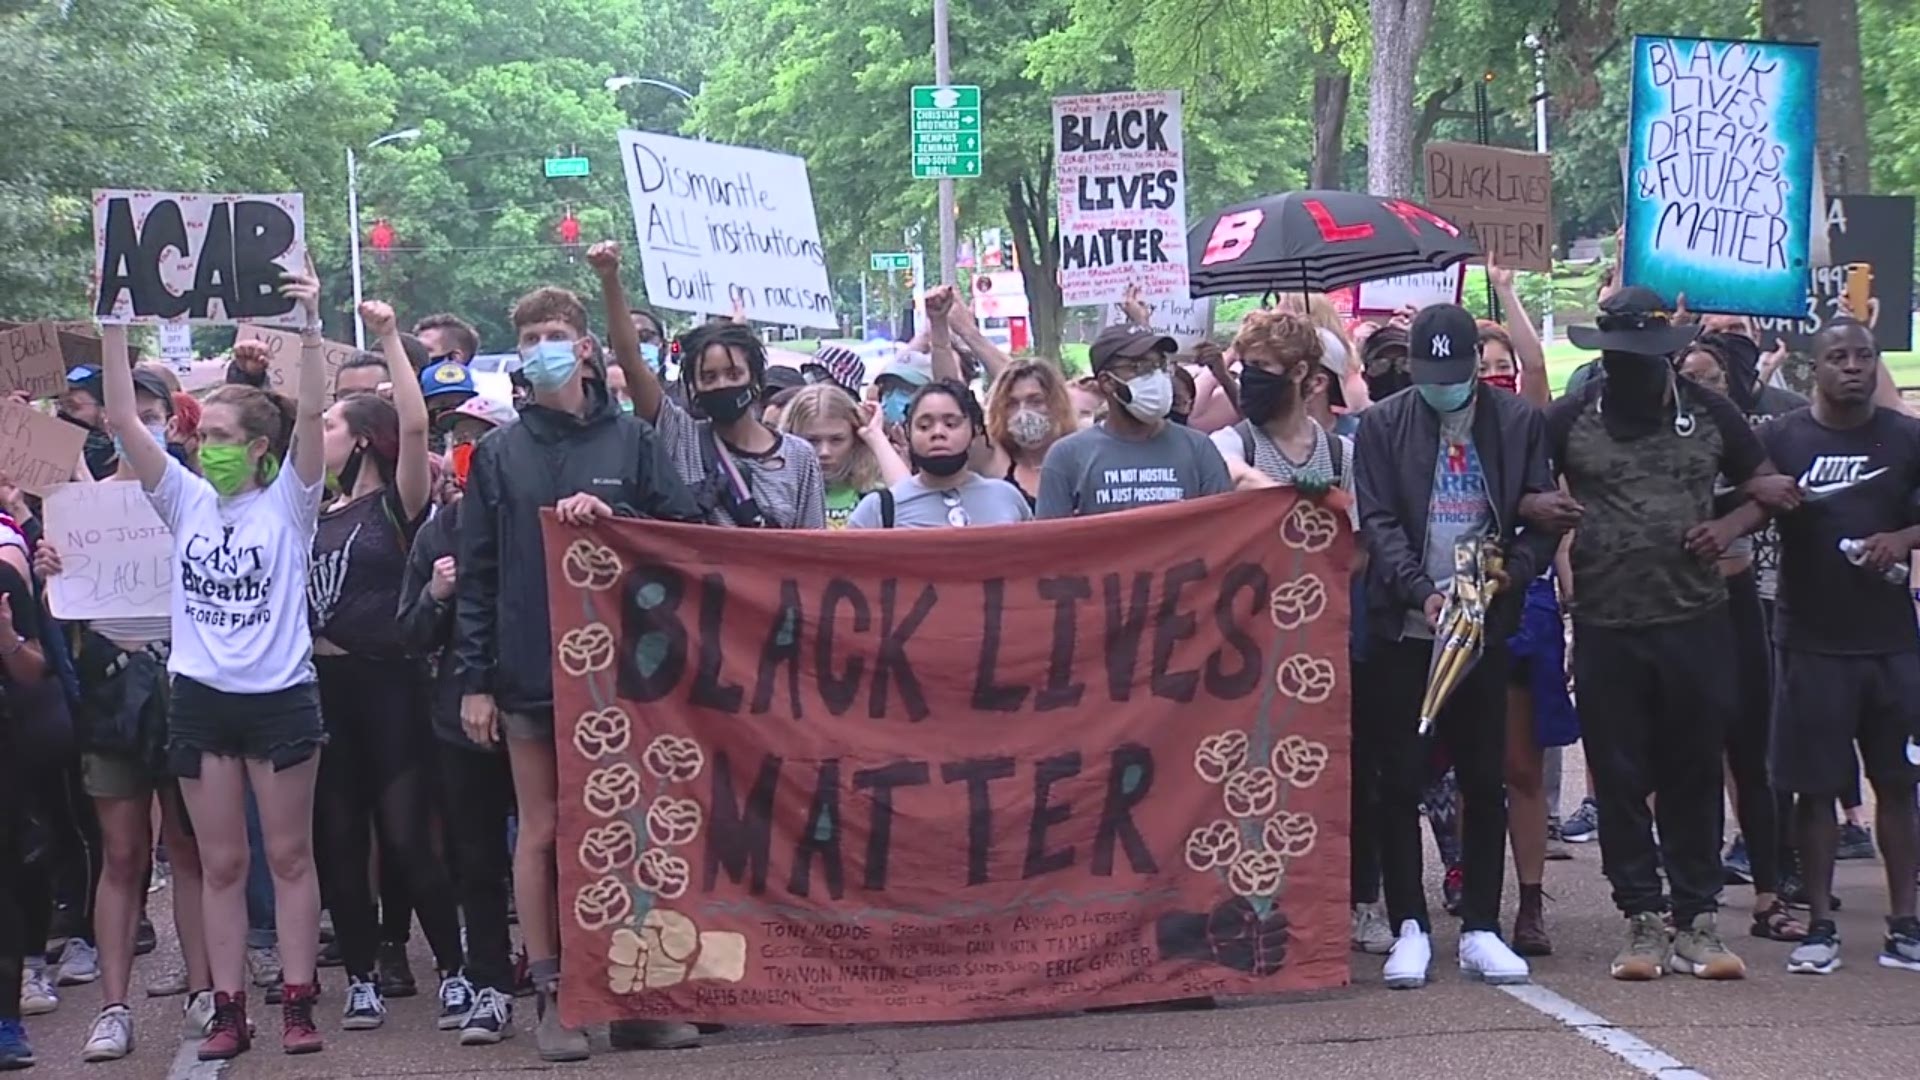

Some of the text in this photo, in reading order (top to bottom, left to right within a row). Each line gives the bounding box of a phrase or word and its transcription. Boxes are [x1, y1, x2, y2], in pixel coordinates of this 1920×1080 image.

[1650, 39, 1777, 98] BLACK
[917, 111, 959, 119] CHRISTIAN
[1672, 78, 1768, 133] LIVES,
[1061, 108, 1168, 152] BLACK
[633, 143, 776, 210] Dismantle
[1078, 169, 1178, 211] LIVES
[1430, 152, 1549, 204] BLACK LIVES
[648, 203, 826, 266] ALL institutions
[1063, 228, 1168, 270] MATTER
[1465, 220, 1544, 263] ATTER!
[1656, 201, 1787, 269] MATTER
[97, 198, 296, 318] ACAB
[662, 262, 833, 313] built on racism
[1104, 469, 1120, 483] I'M
[1121, 469, 1138, 483] NOT
[1809, 456, 1869, 482] NIKE
[1096, 489, 1111, 504] I'M
[1111, 487, 1132, 503] JUST
[68, 525, 173, 549] NO JUSTI
[185, 533, 265, 576] CAN'T
[616, 558, 1269, 722] BLACK LIVES
[702, 742, 1160, 900] MATTER
[760, 921, 807, 938] TONY
[839, 964, 897, 982] MARTIN
[1046, 957, 1083, 978] ERIC
[1088, 946, 1153, 971] GARNER
